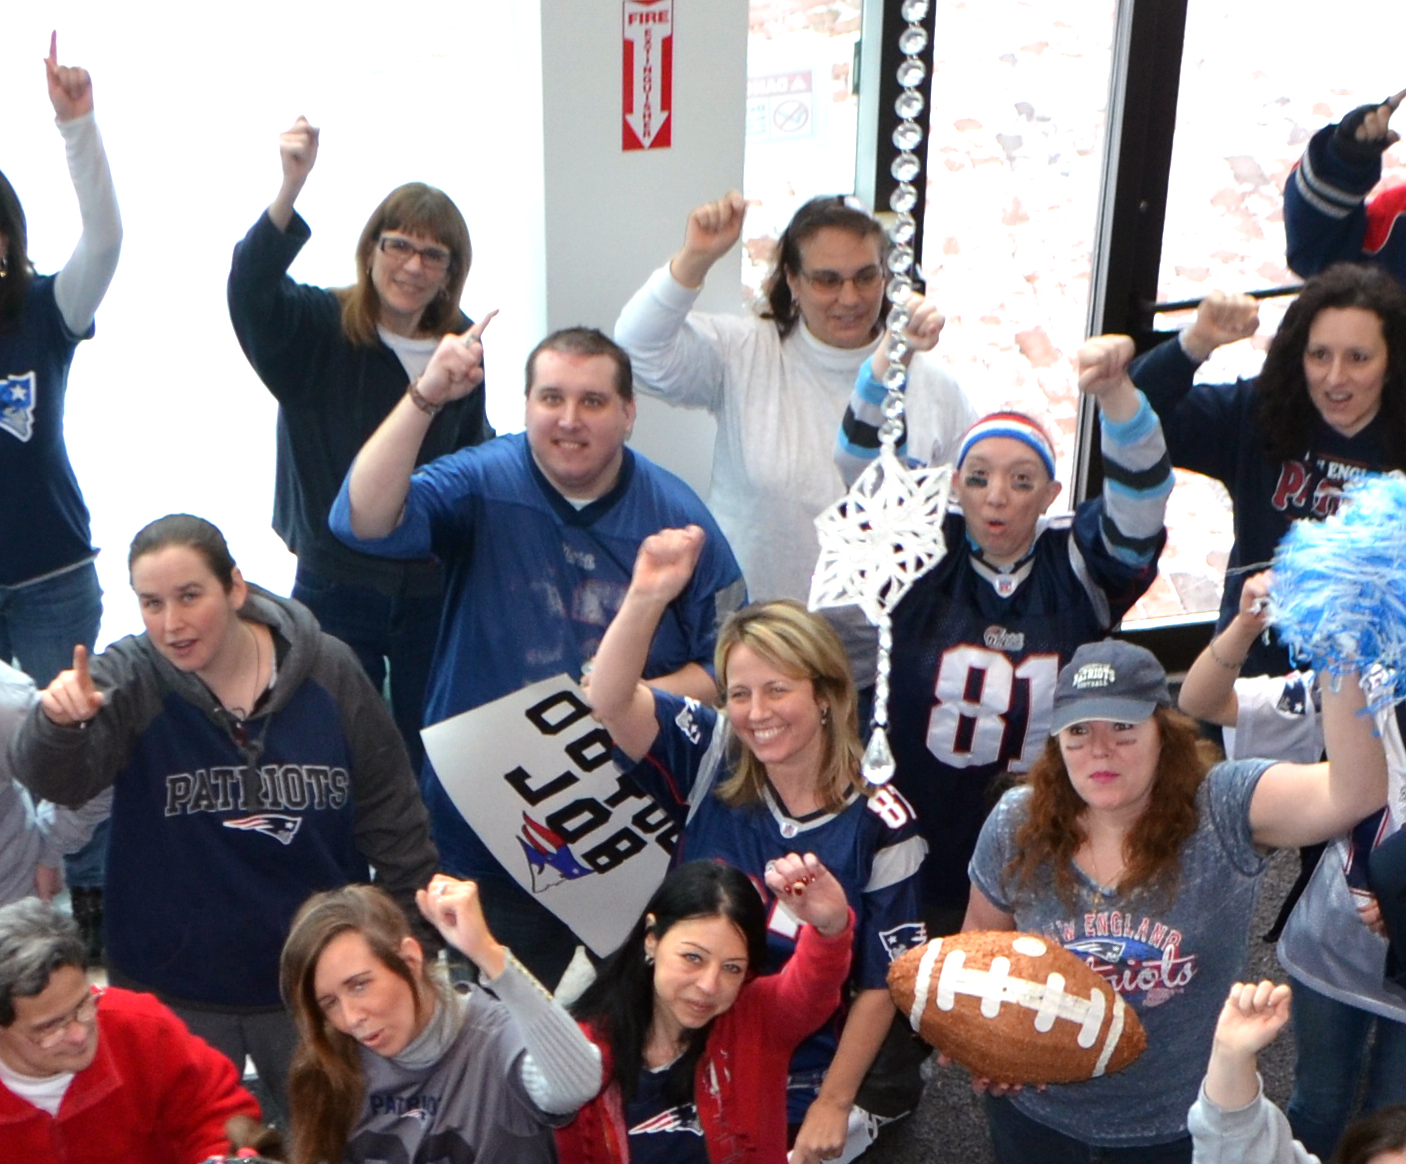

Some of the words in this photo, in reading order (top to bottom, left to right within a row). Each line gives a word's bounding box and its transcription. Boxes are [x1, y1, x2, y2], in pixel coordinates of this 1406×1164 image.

[628, 10, 669, 25] FIRE
[643, 29, 652, 138] EXTINGUISHER
[926, 643, 1060, 774] 81
[504, 765, 648, 875] JOB
[1083, 910, 1183, 951] ENGLAND
